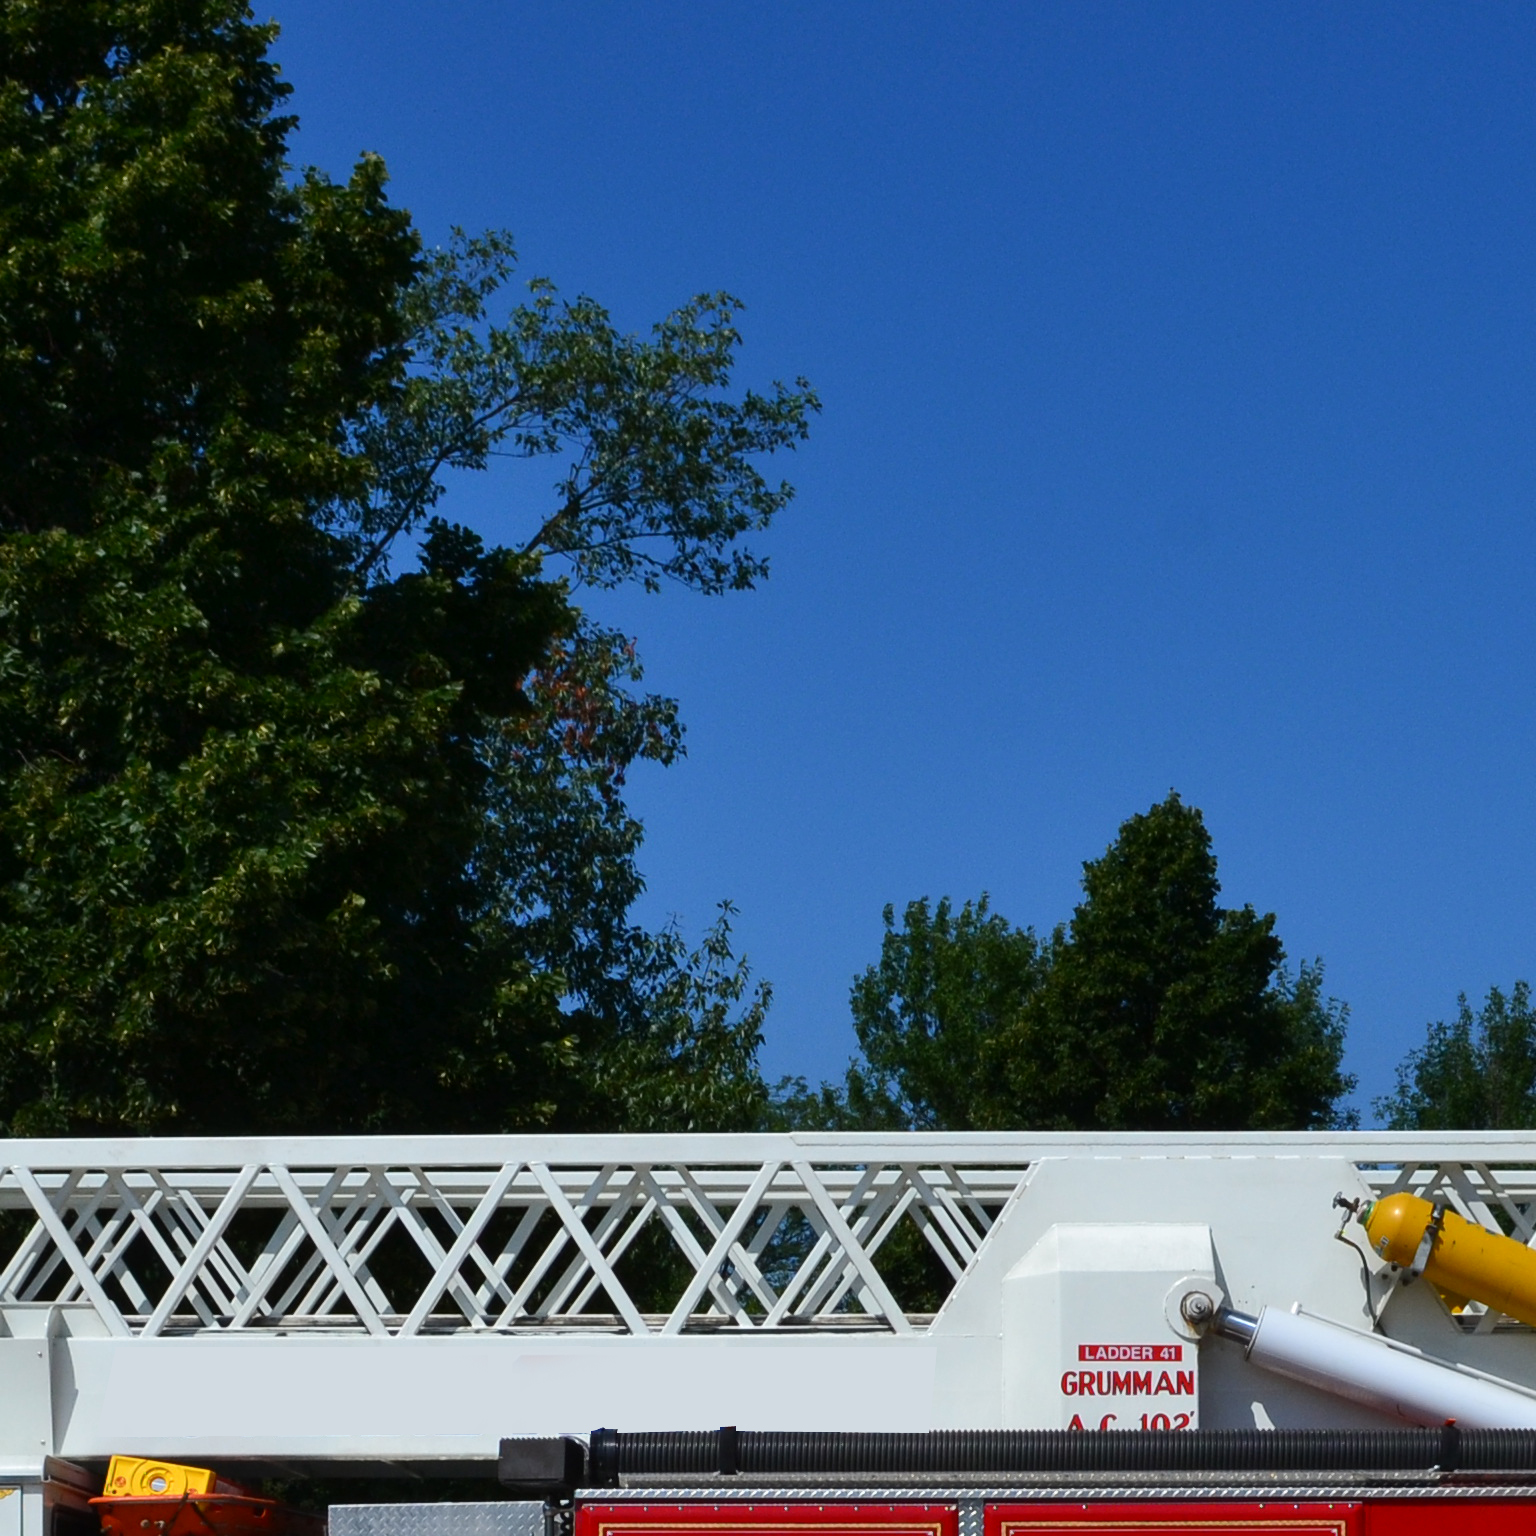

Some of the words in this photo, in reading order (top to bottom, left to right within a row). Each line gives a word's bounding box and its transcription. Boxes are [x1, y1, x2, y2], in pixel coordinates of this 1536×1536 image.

[1085, 1346, 1154, 1360] LADDER
[1160, 1346, 1176, 1360] 41
[1060, 1370, 1195, 1396] GRUMMAN
